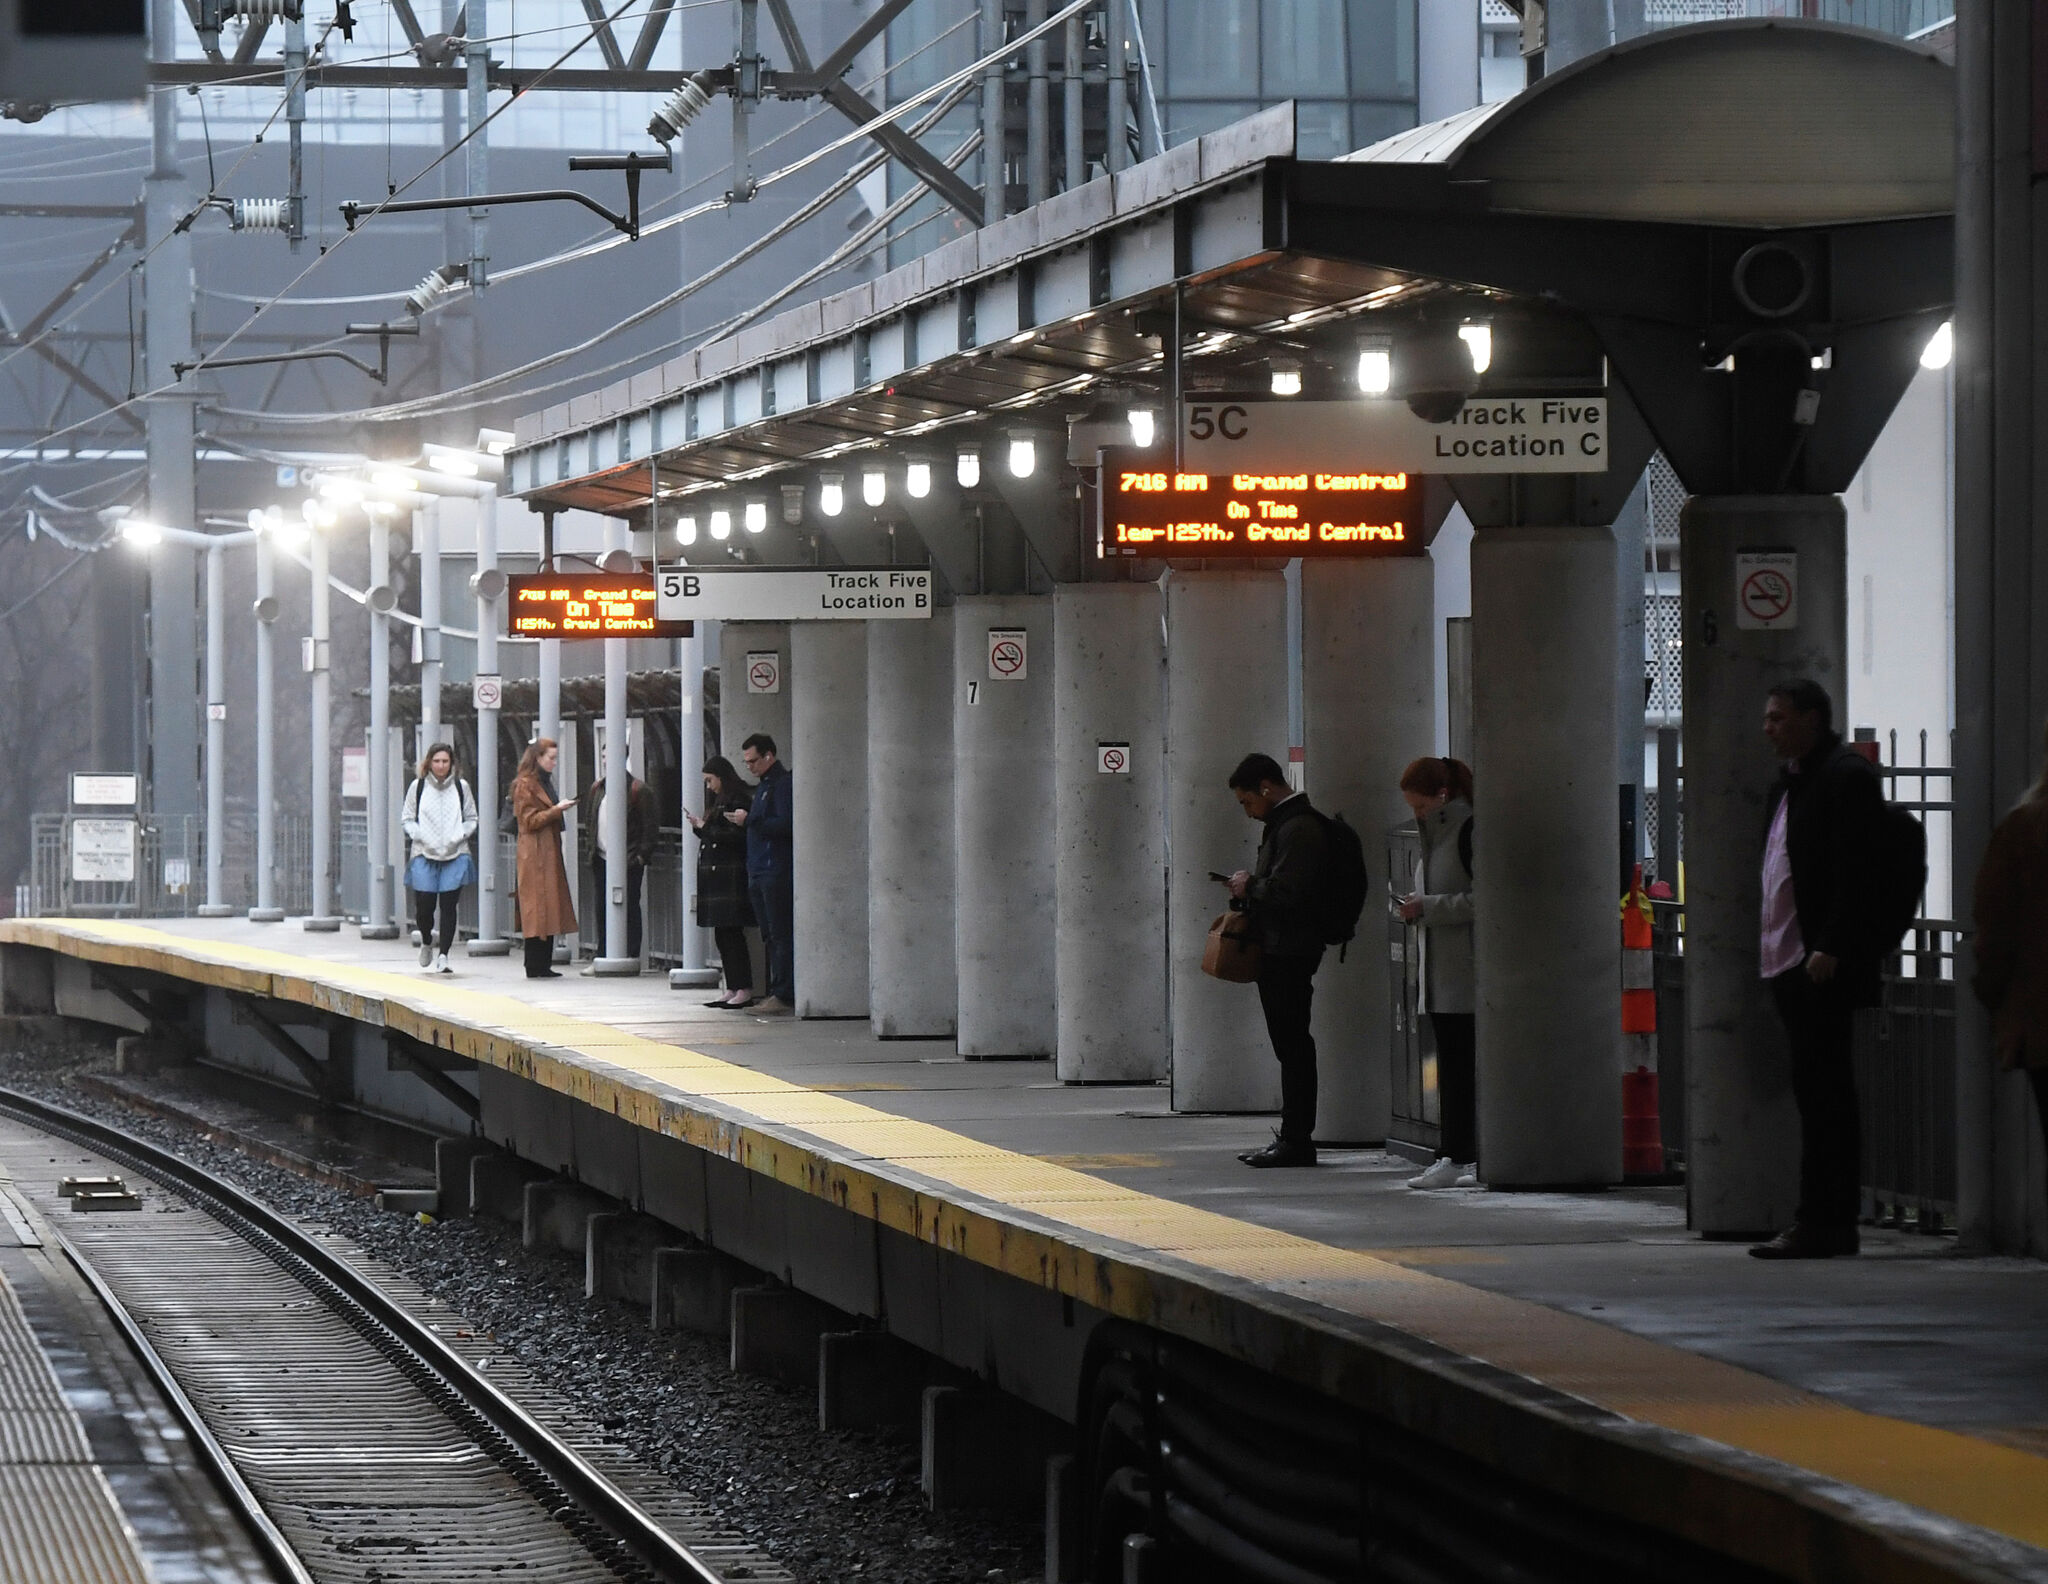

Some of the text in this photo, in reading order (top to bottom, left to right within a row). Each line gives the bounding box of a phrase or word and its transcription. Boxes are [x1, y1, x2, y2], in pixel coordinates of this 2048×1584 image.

[1542, 401, 1600, 424] Five
[1190, 406, 1248, 440] 5C
[1436, 432, 1601, 457] Location C
[1175, 473, 1208, 491] AM
[1233, 474, 1308, 491] Grand
[1315, 472, 1407, 490] Central
[1227, 500, 1298, 519] On Time
[1247, 523, 1310, 541] Grand
[1319, 521, 1405, 541] Central
[664, 575, 701, 597] 5B
[827, 573, 927, 588] Track Five
[583, 589, 628, 601] Grand
[821, 593, 927, 609] Location B
[566, 601, 635, 617] On Time
[563, 617, 600, 630] Grand
[604, 617, 655, 630] Central
[968, 681, 978, 704] 7
